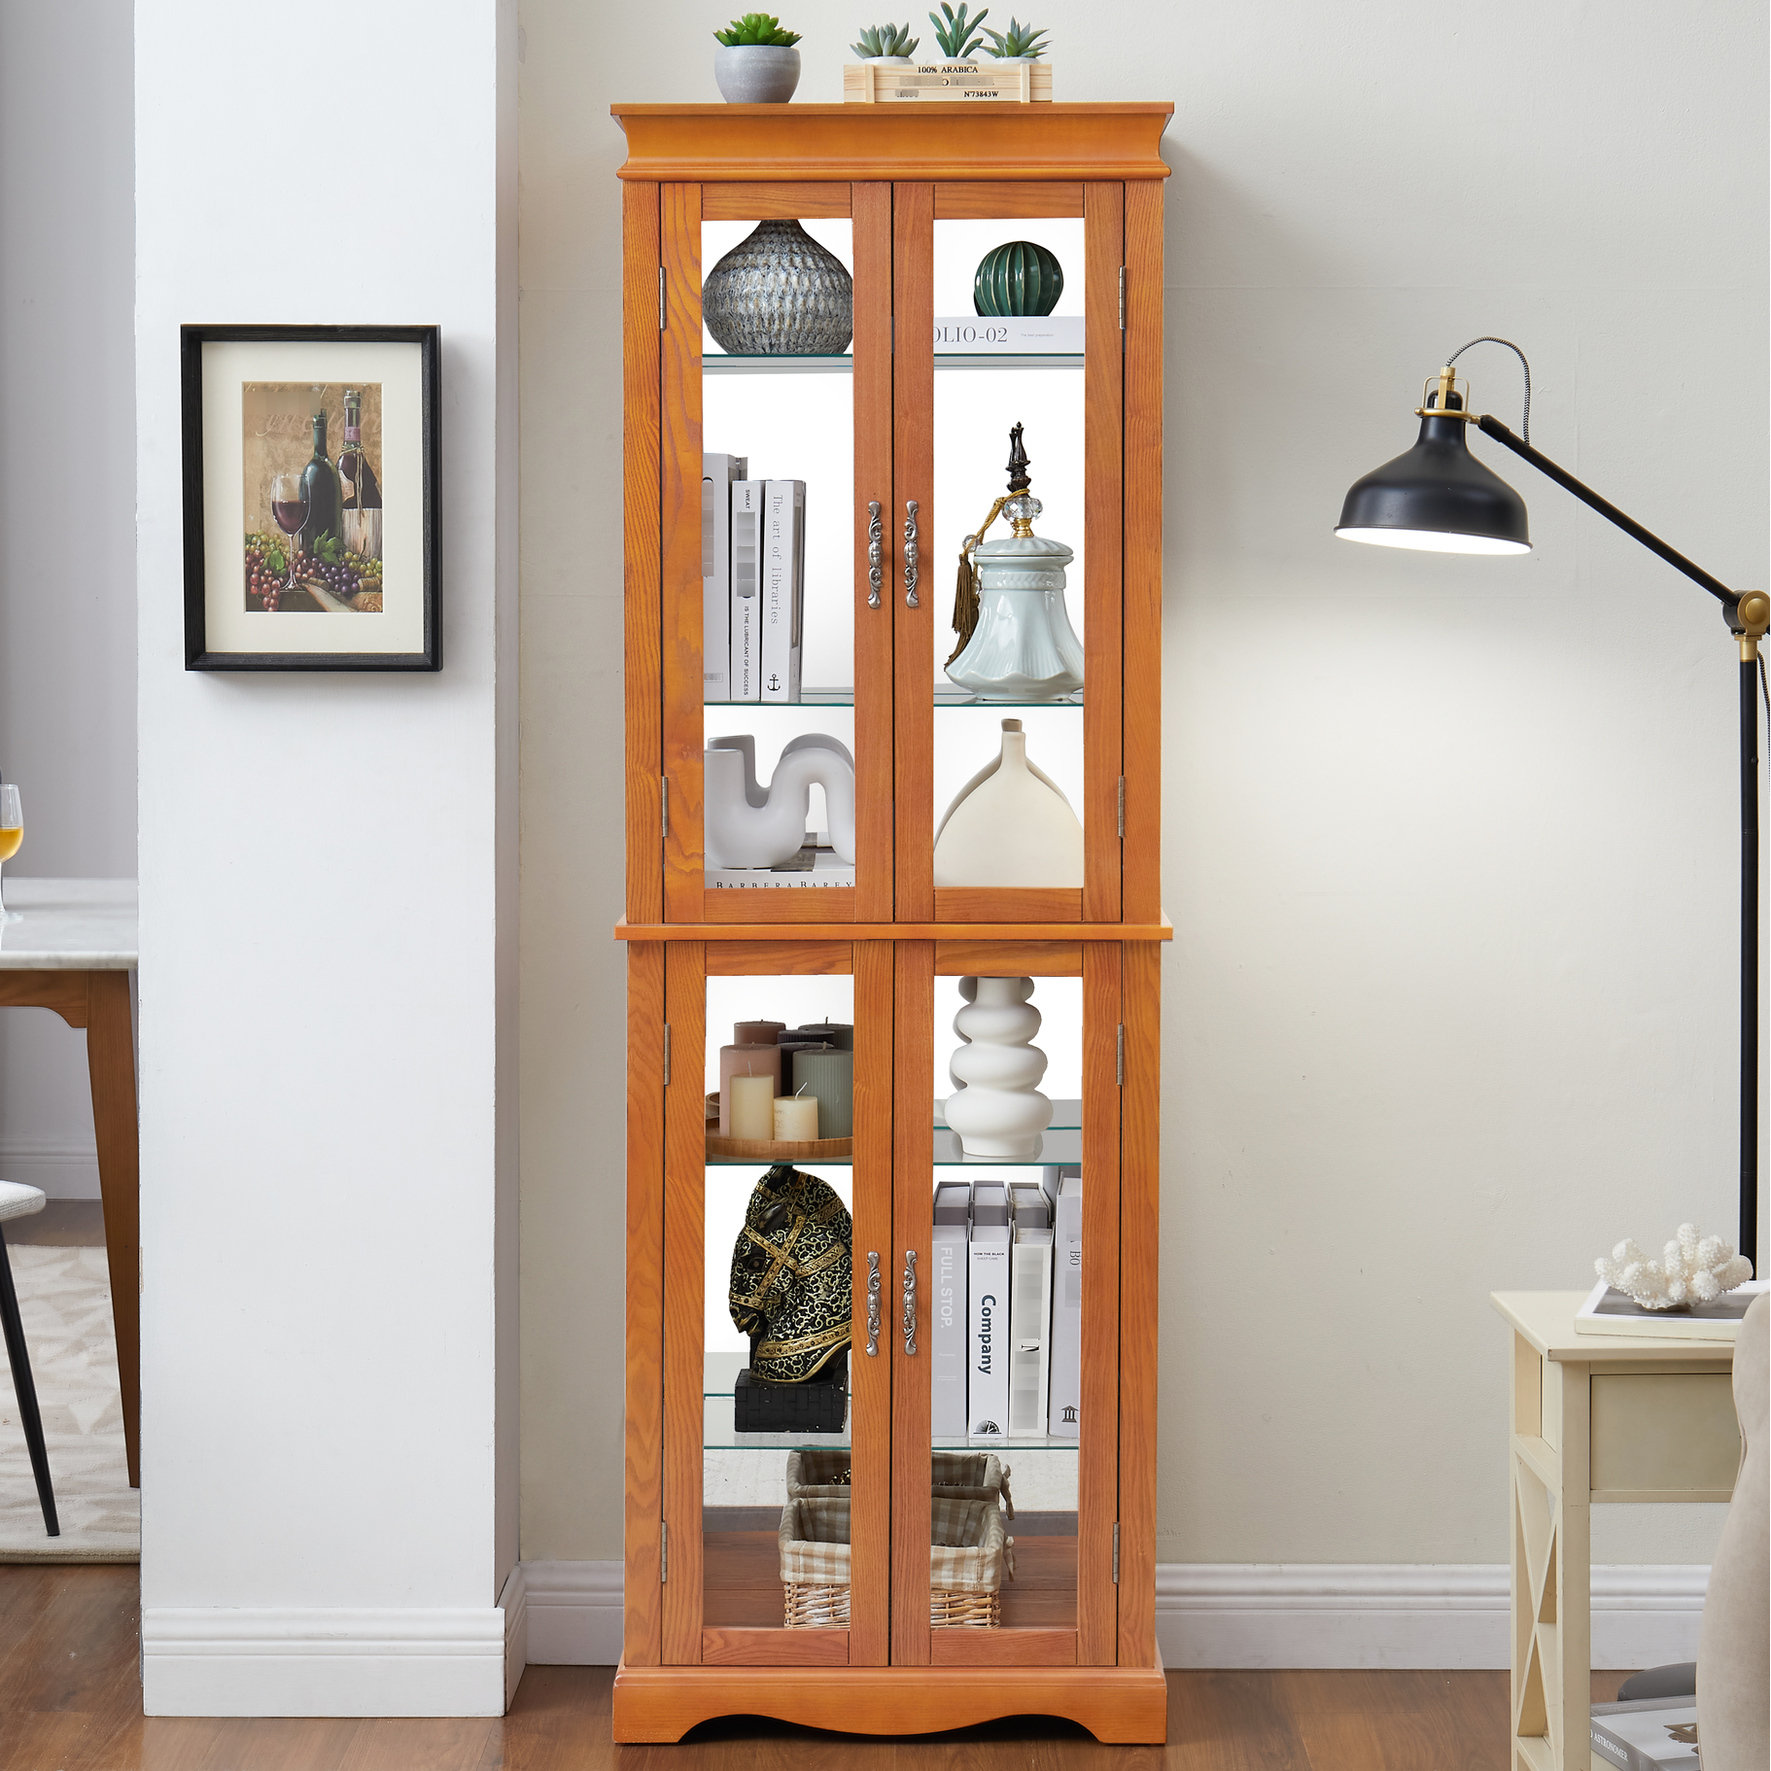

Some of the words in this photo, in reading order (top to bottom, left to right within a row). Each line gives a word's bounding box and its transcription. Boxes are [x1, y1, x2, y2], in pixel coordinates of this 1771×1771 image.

[918, 66, 938, 74] 100%
[941, 66, 979, 74] ARABICA
[773, 495, 783, 514] The
[772, 520, 781, 540] art
[772, 547, 782, 560] of
[770, 567, 783, 625] libraries
[744, 658, 750, 667] OF
[941, 1247, 953, 1284] FULL
[941, 1287, 953, 1329] STOP.
[977, 1294, 997, 1375] Company
